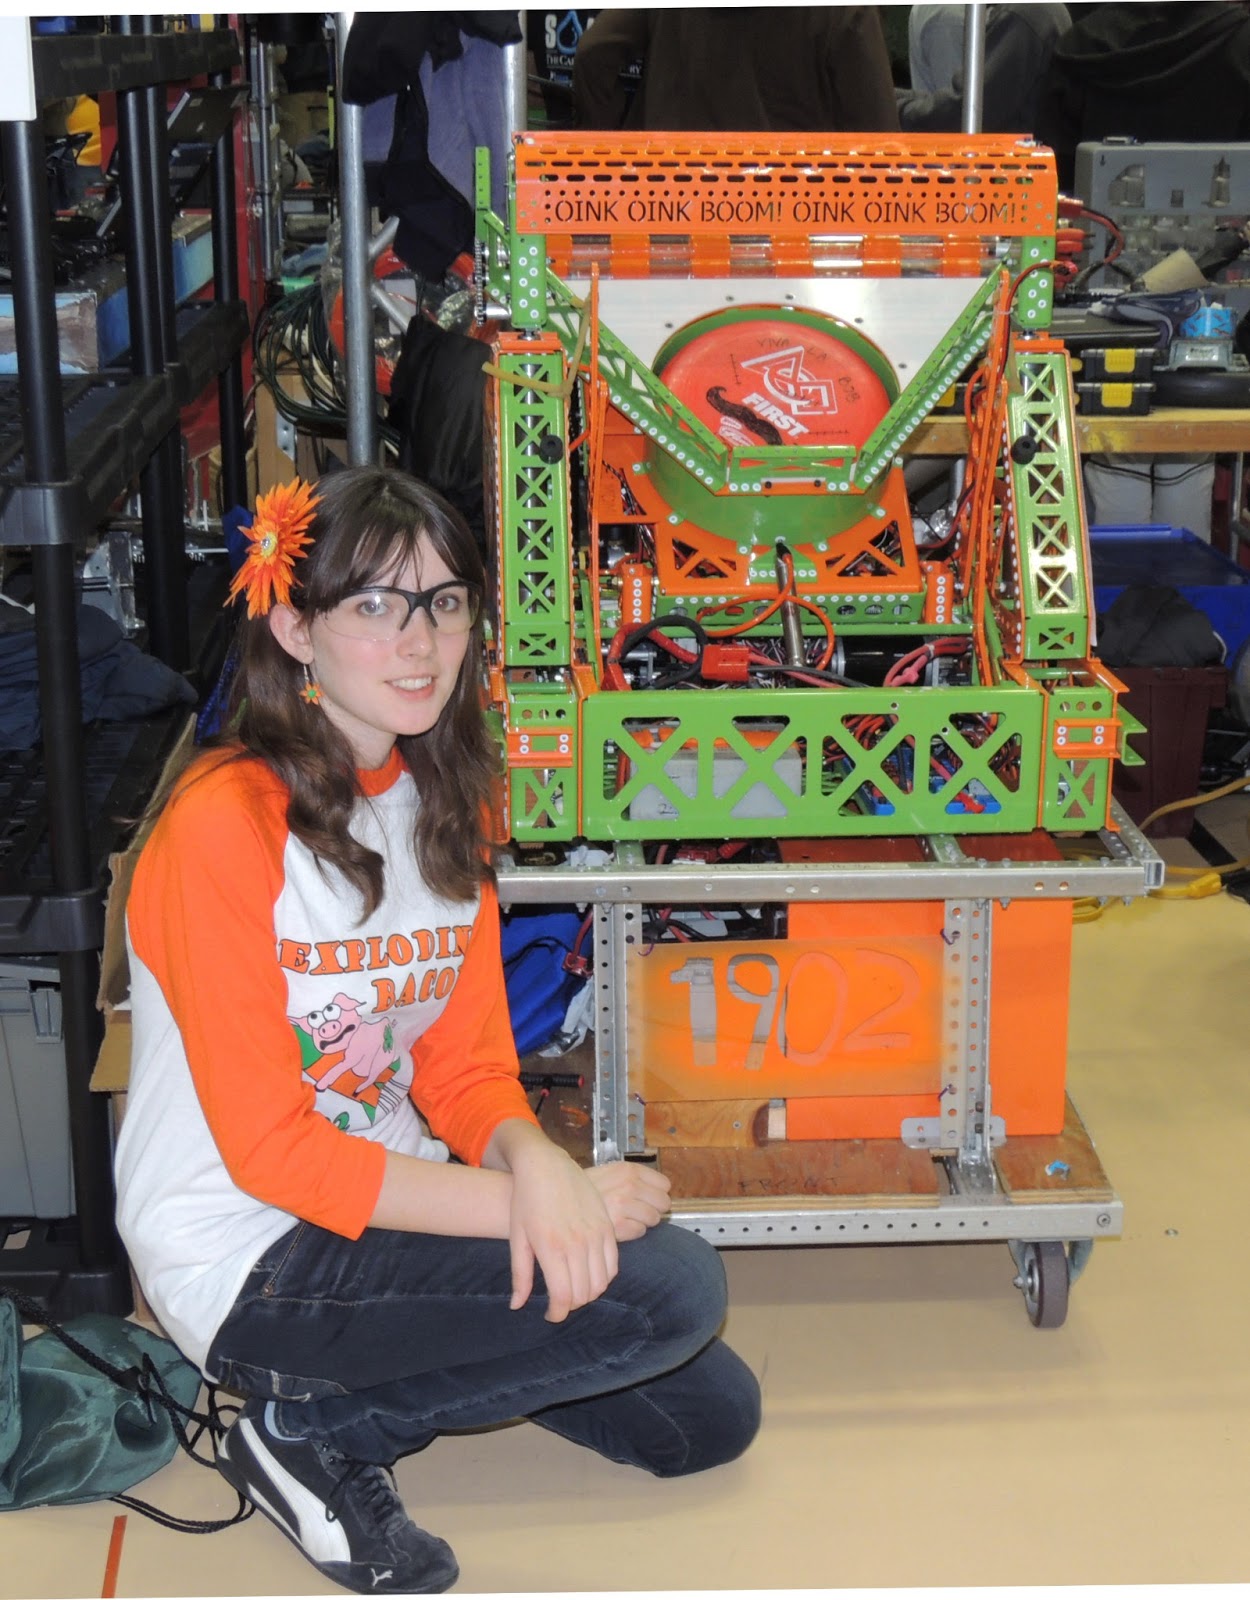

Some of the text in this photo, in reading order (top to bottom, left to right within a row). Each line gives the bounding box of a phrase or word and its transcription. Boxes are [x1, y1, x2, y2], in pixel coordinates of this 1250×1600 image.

[554, 200, 1017, 224] OINK OINK BOOM! OINK OINK BOOM!
[741, 392, 811, 438] FIRST
[278, 925, 473, 976] EXPLODIN
[371, 966, 463, 1014] BACO
[669, 947, 922, 1072] 1902
